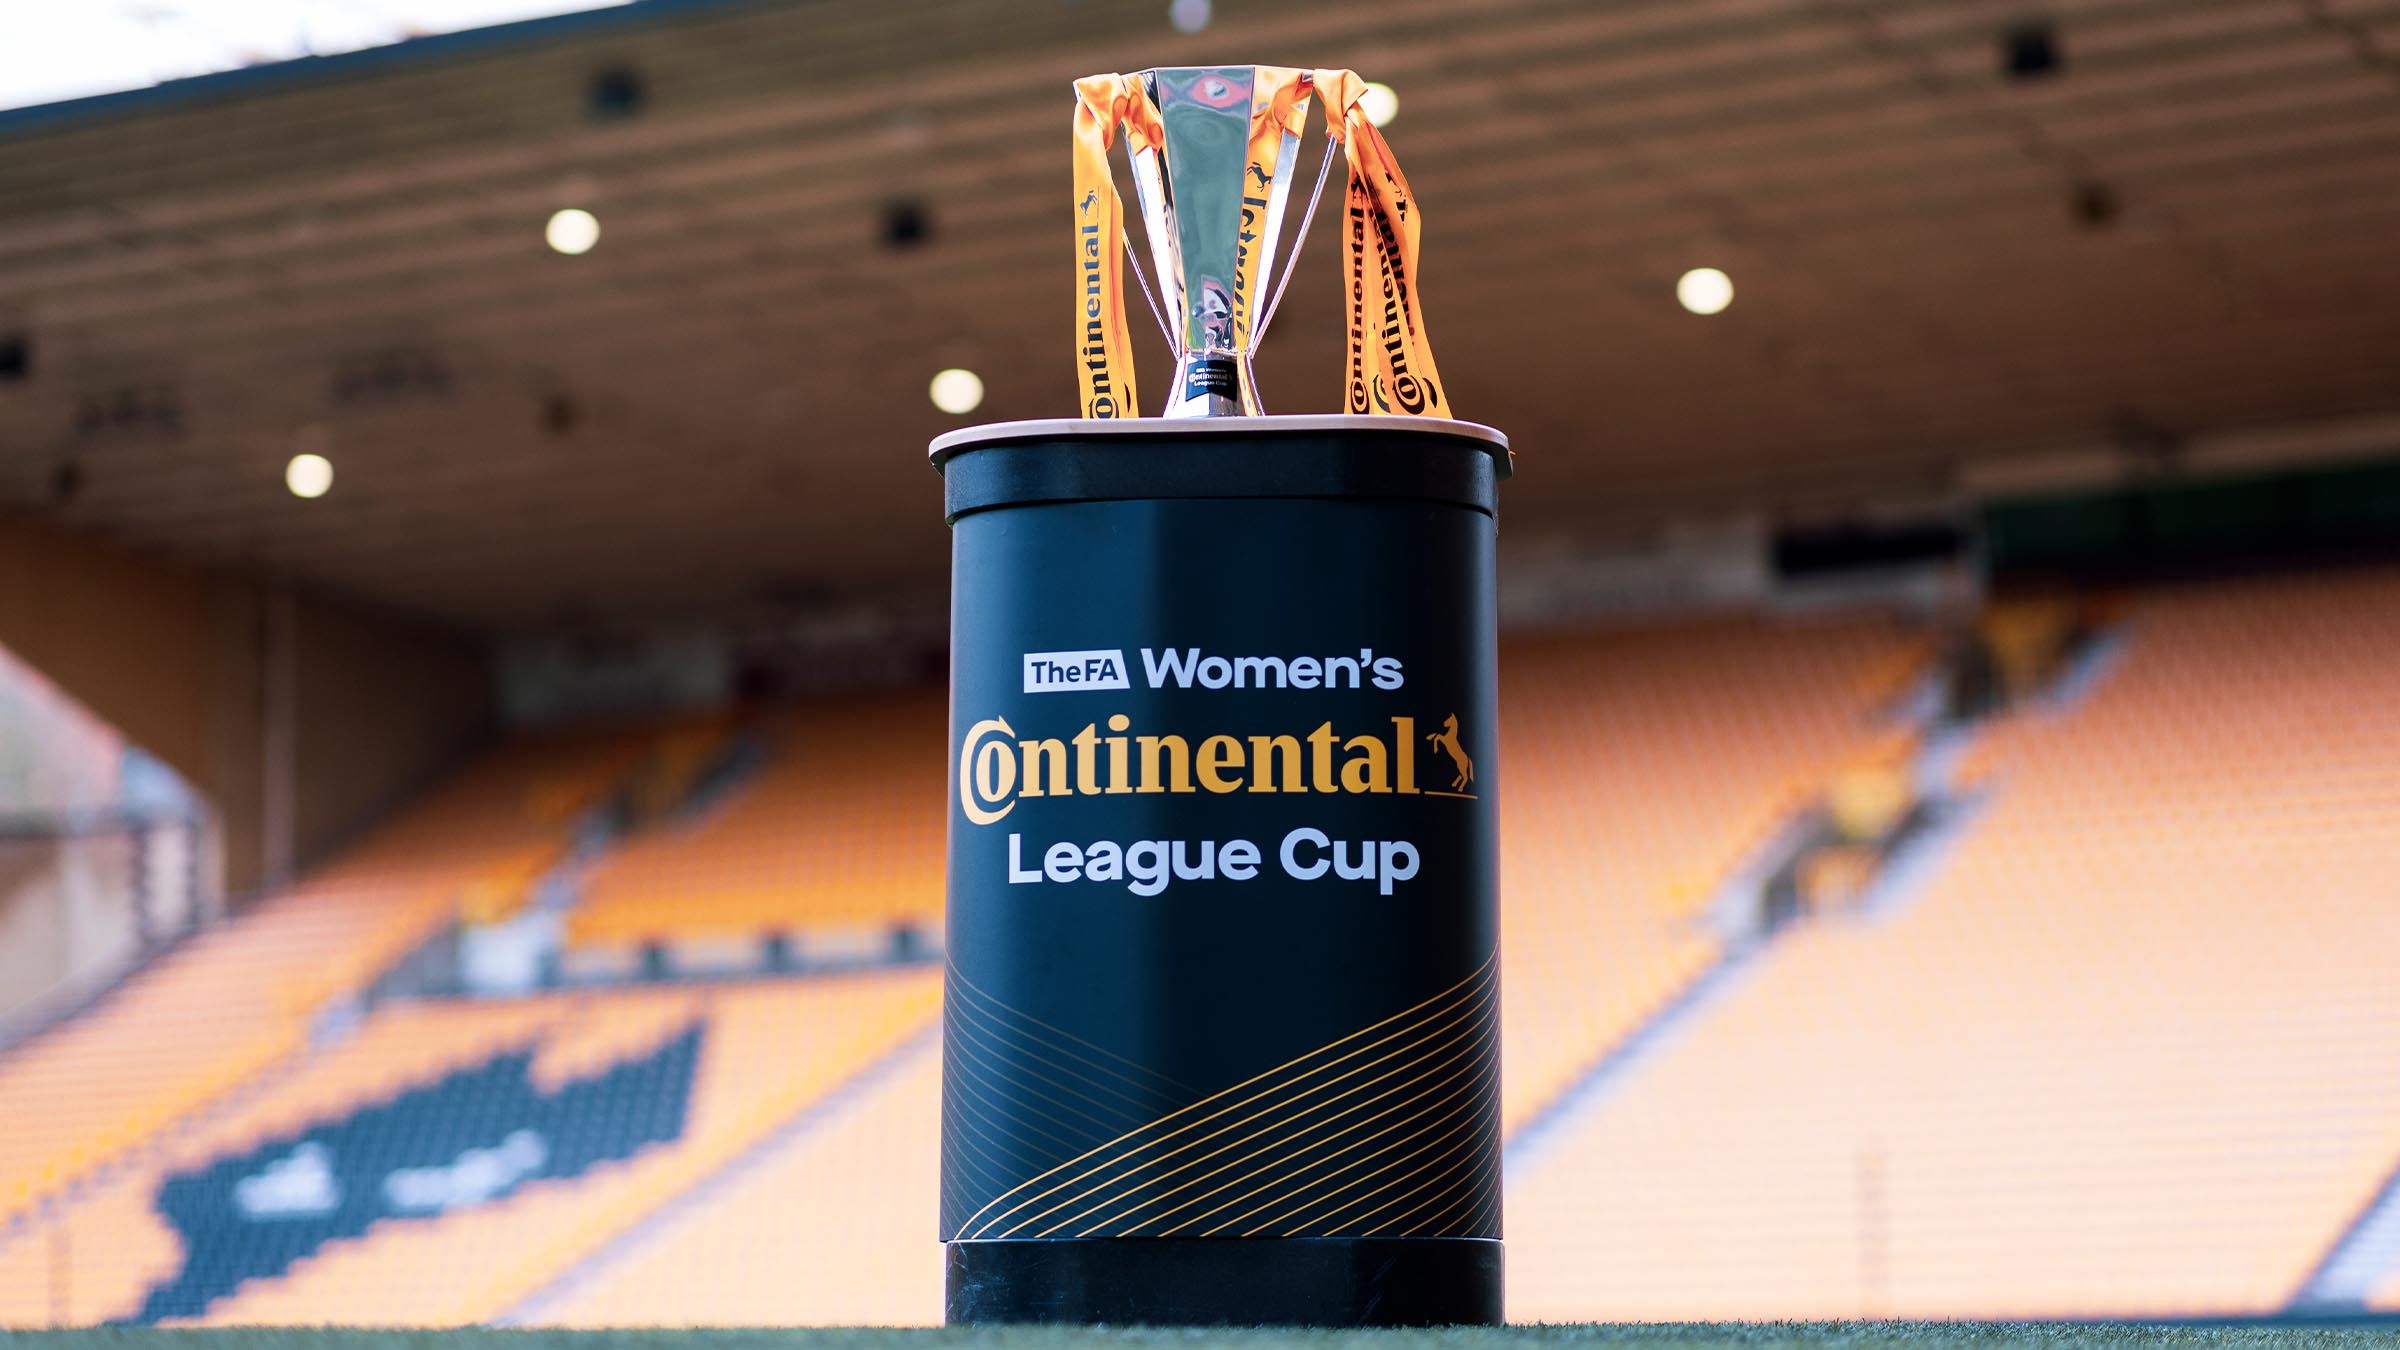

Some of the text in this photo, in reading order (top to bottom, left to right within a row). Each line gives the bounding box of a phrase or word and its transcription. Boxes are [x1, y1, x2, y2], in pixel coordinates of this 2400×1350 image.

[960, 714, 1420, 826] Continental
[1008, 827, 1420, 897] League Cup
